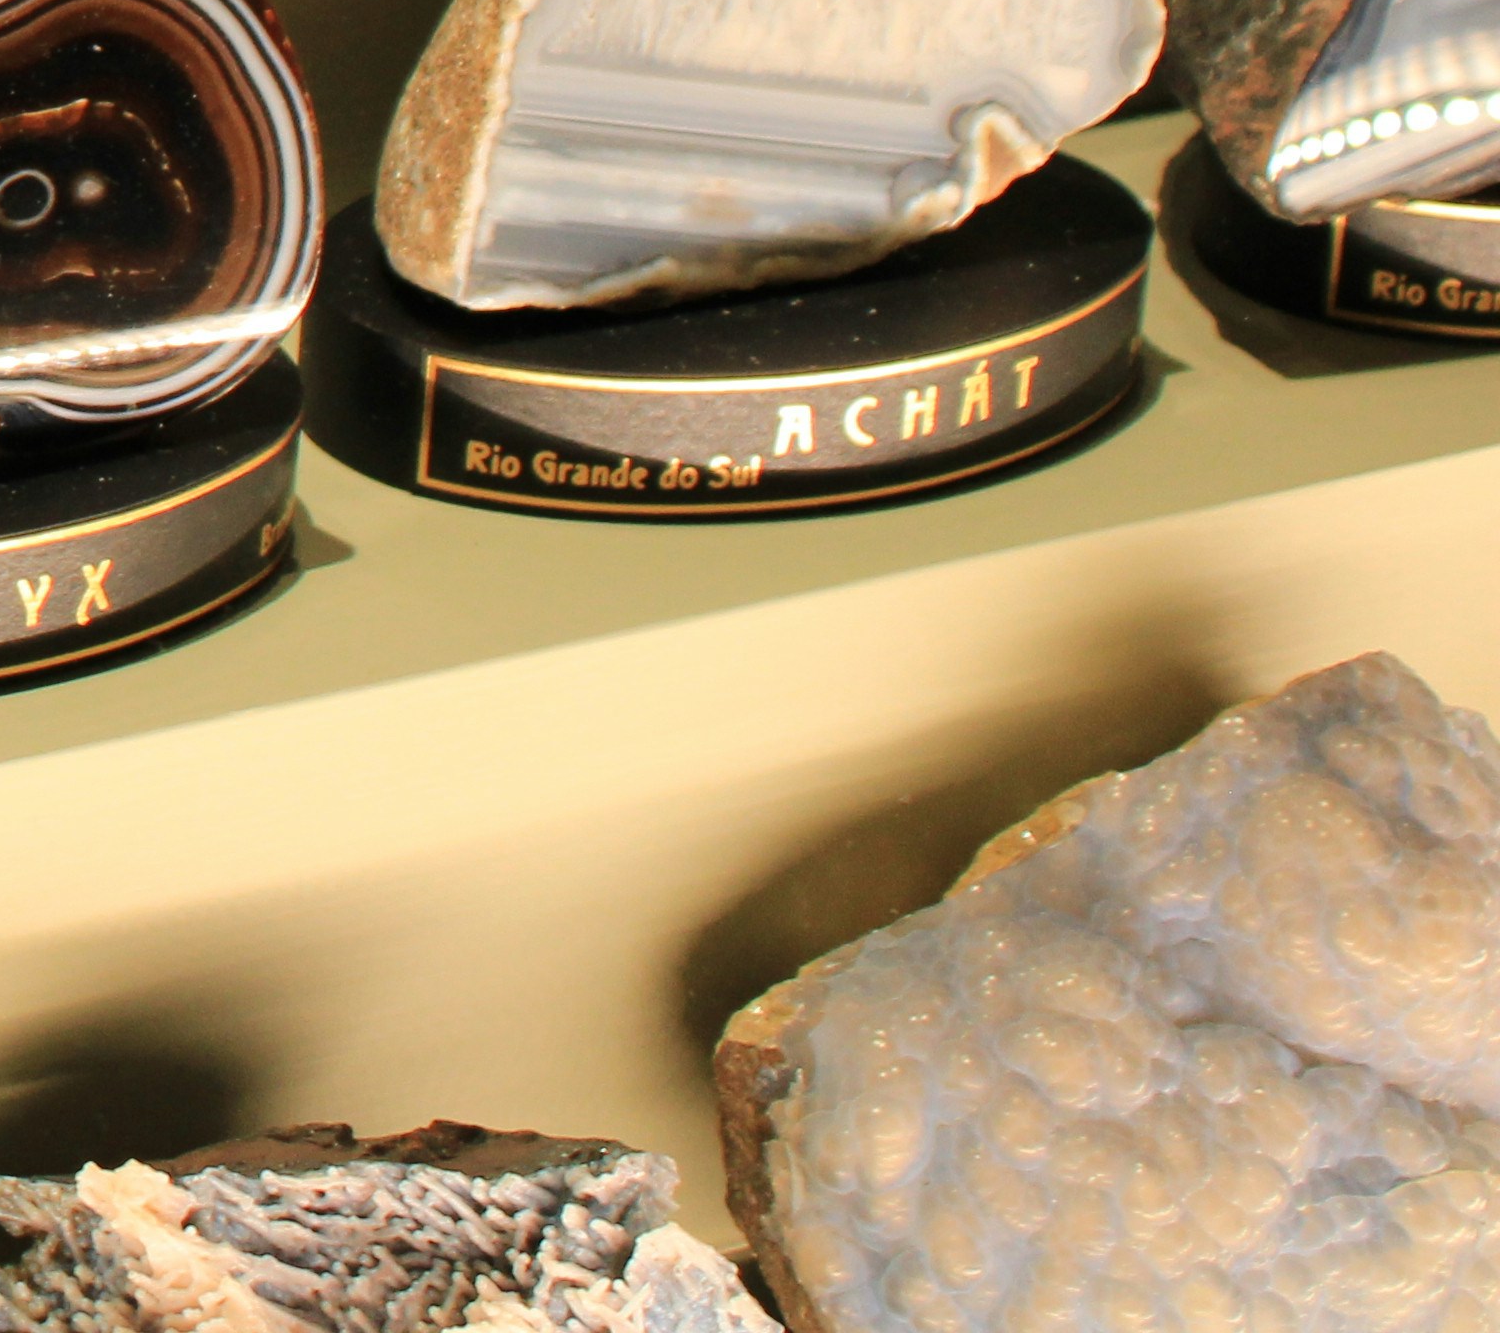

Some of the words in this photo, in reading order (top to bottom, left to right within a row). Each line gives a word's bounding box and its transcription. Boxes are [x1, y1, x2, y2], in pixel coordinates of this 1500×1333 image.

[1372, 270, 1427, 304] Rio
[775, 358, 1038, 455] ACHÁT
[466, 441, 522, 479] Rio
[534, 450, 647, 489] Grande
[659, 458, 698, 489] do
[708, 455, 762, 488] Sul
